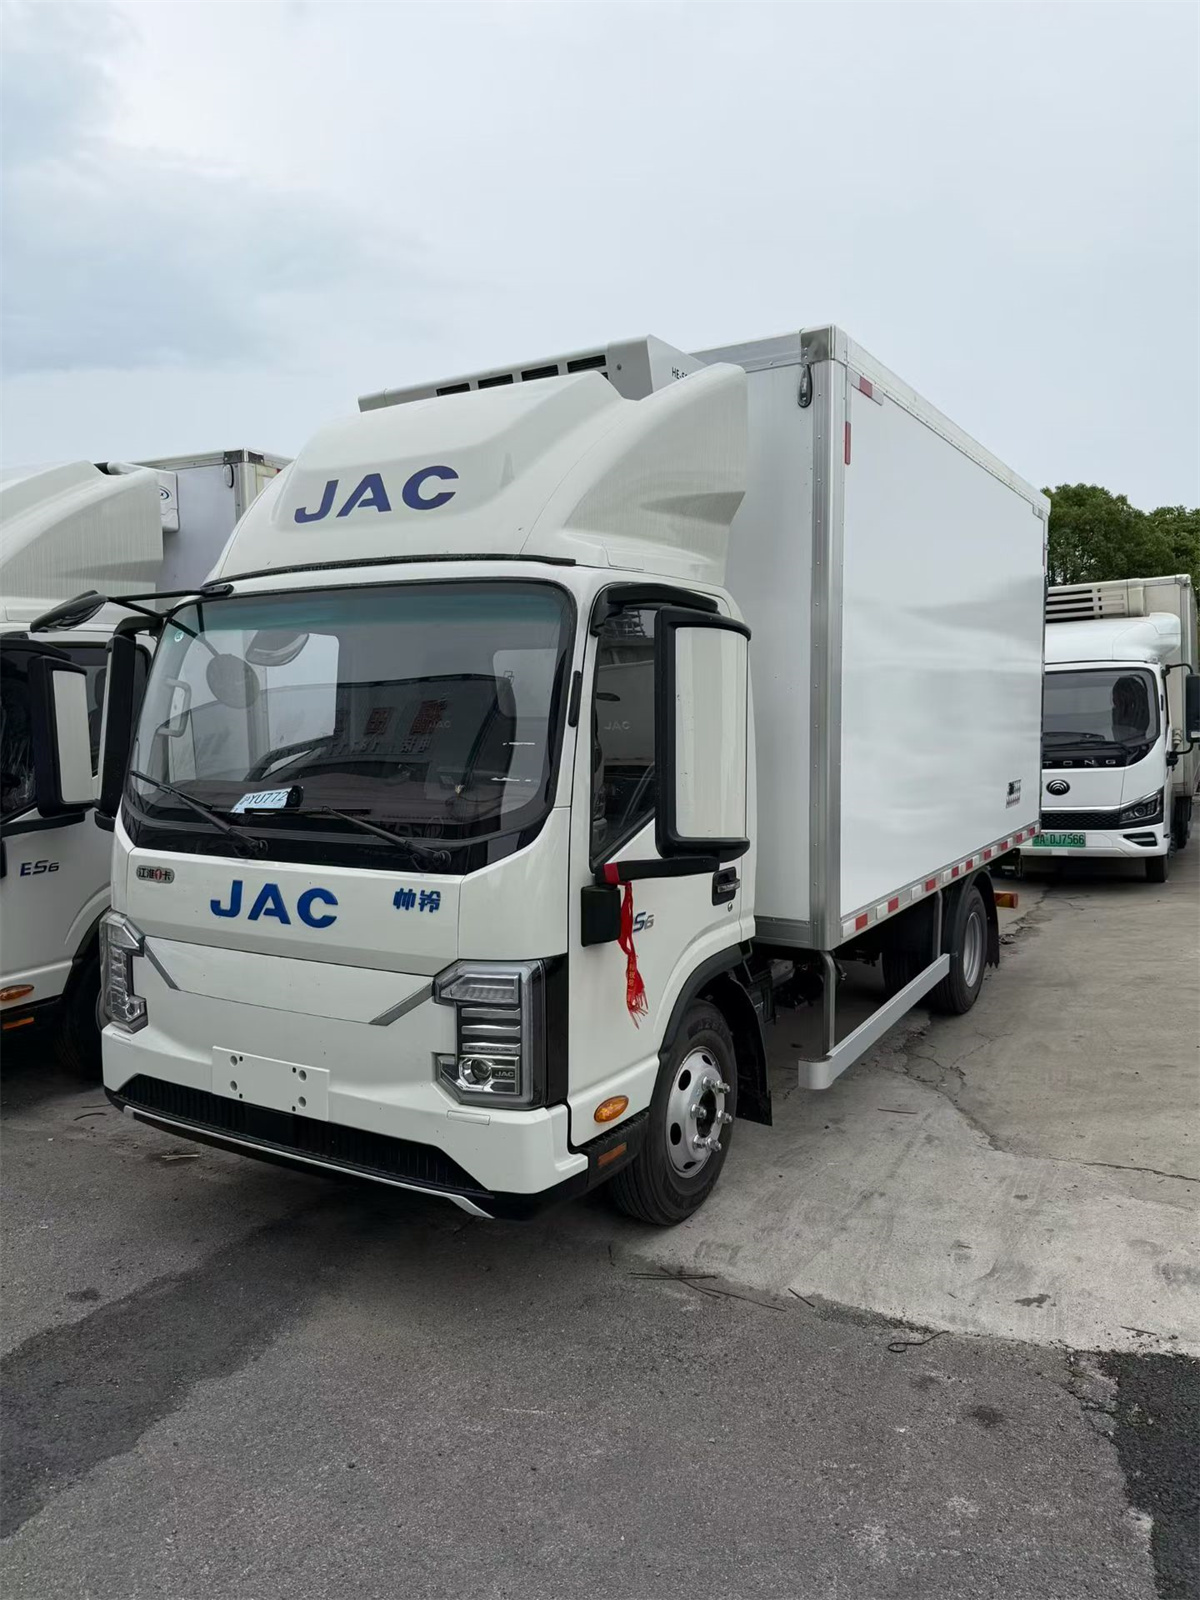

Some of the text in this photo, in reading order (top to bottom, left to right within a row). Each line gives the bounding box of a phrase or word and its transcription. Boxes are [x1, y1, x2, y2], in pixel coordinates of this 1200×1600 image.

[294, 465, 459, 523] JAC
[604, 721, 631, 730] JAC
[20, 859, 60, 877] ES6
[210, 879, 339, 928] JAC
[633, 911, 655, 933] S6
[495, 1070, 515, 1078] JAC
